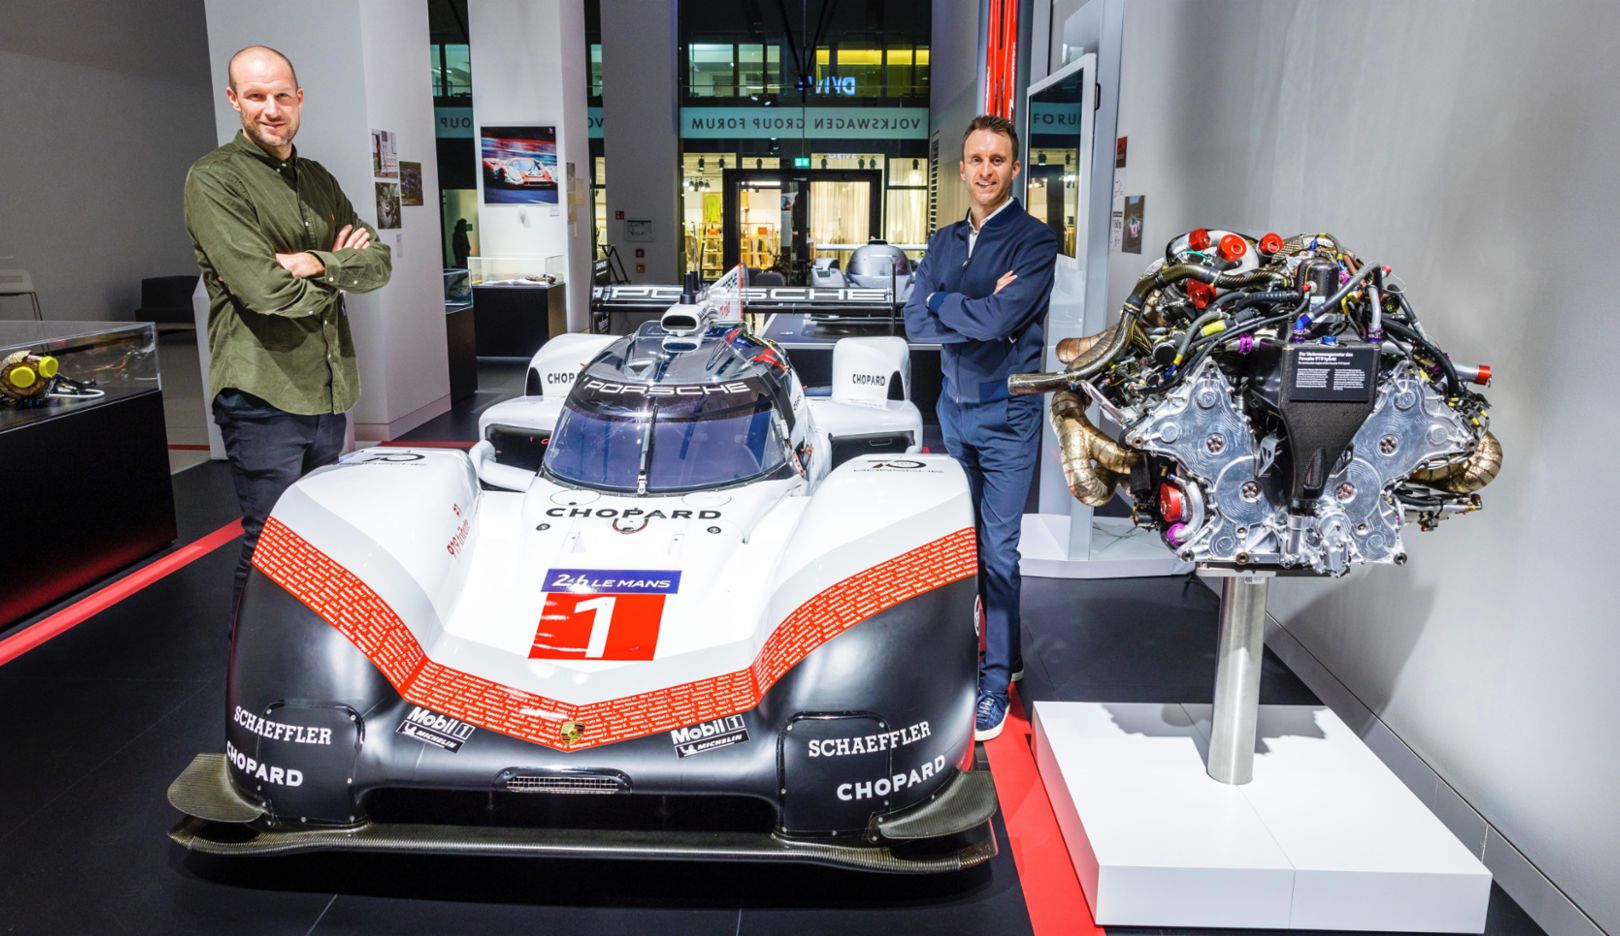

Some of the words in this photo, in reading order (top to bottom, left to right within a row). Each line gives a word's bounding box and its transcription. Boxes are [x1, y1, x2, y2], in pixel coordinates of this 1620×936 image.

[611, 286, 886, 302] POSCHE
[583, 380, 751, 397] PORSCHE
[852, 373, 886, 387] CHOPARD
[546, 507, 722, 520] CHOPARD
[591, 579, 616, 587] LE
[616, 580, 671, 589] MANS
[574, 596, 616, 658] 1
[233, 705, 332, 746] SCHAEFFLER
[407, 706, 459, 734] Mobil
[670, 718, 726, 745] Mobil
[415, 730, 458, 749] MICHELIN
[697, 734, 743, 751] MICHELIN
[808, 720, 931, 758] SCHAEFFLER
[226, 740, 304, 788] CHOPARD
[836, 754, 946, 801] CHOPARD
